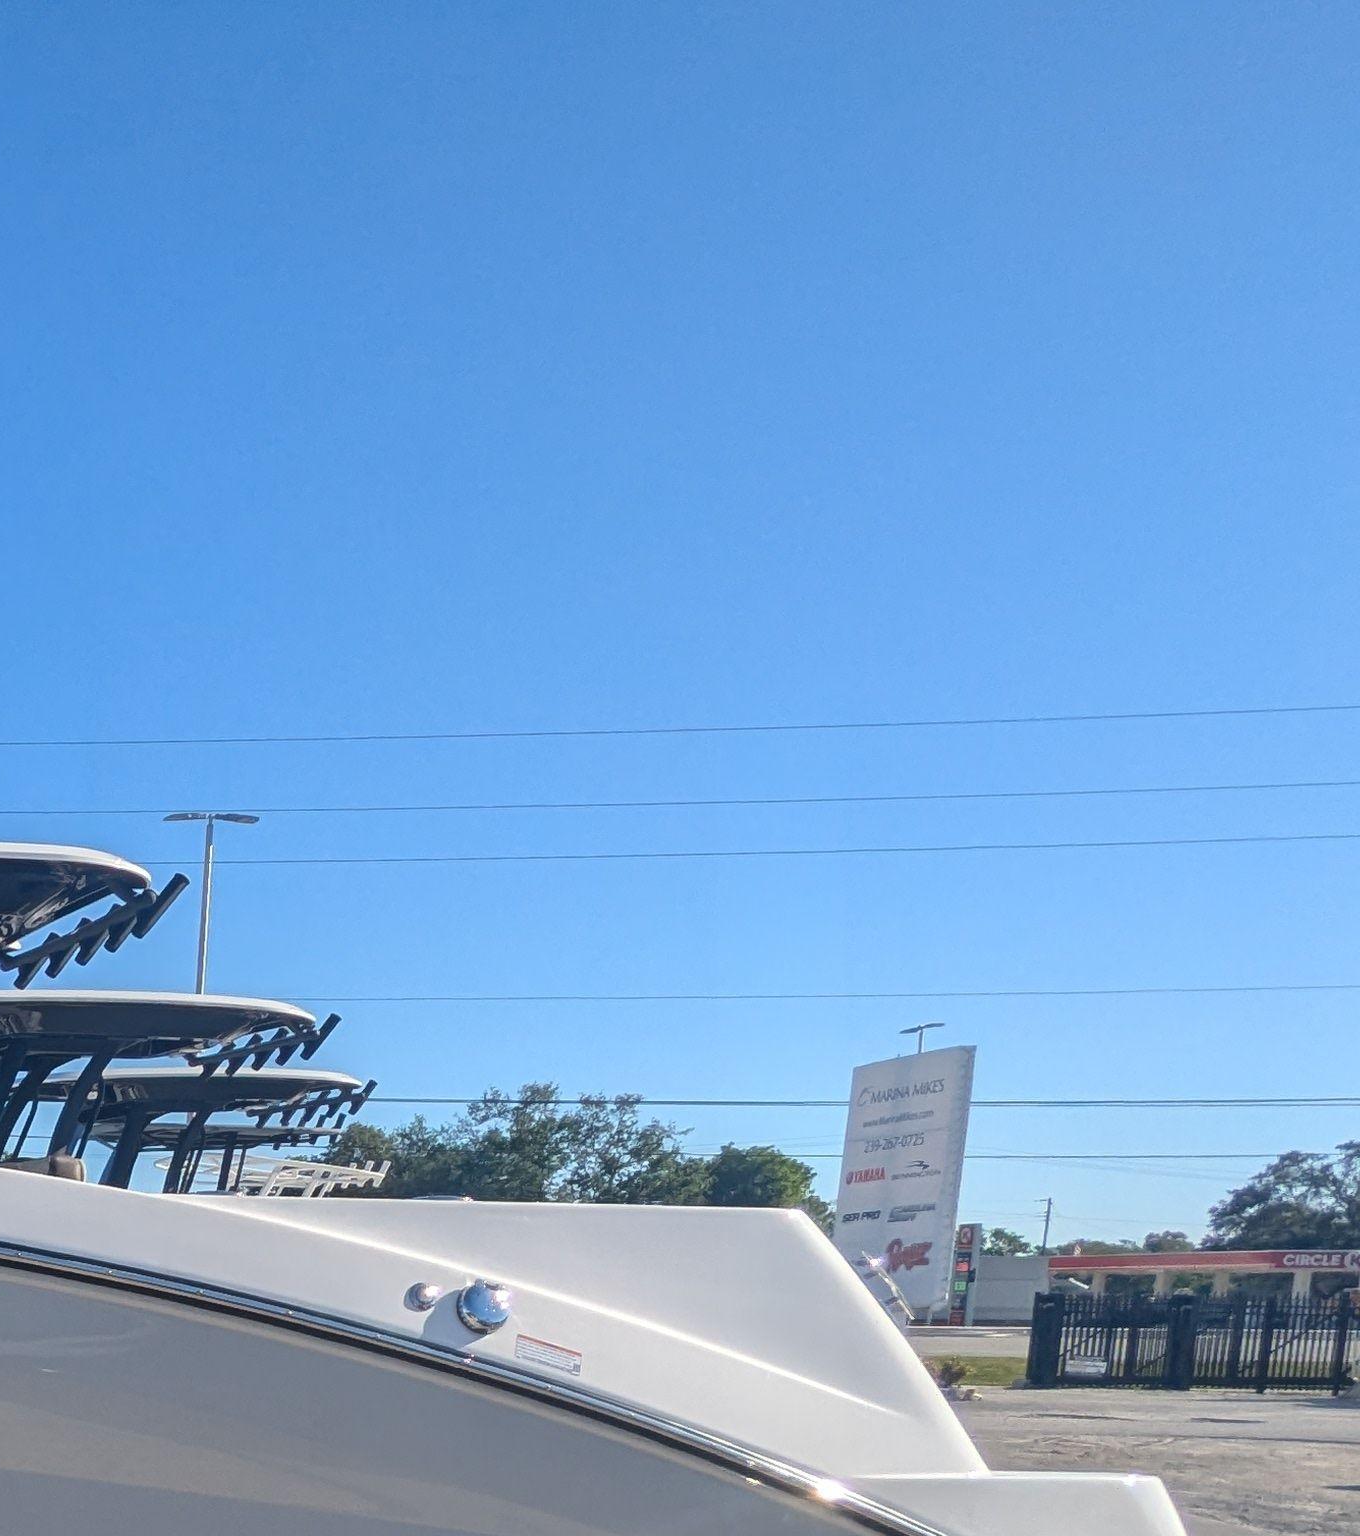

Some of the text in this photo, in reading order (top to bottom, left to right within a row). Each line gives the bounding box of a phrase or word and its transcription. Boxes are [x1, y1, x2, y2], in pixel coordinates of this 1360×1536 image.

[870, 1078, 945, 1104] MARINA MIKES
[853, 1167, 886, 1183] YAMAHA
[1283, 1253, 1341, 1266] CIRCLE
